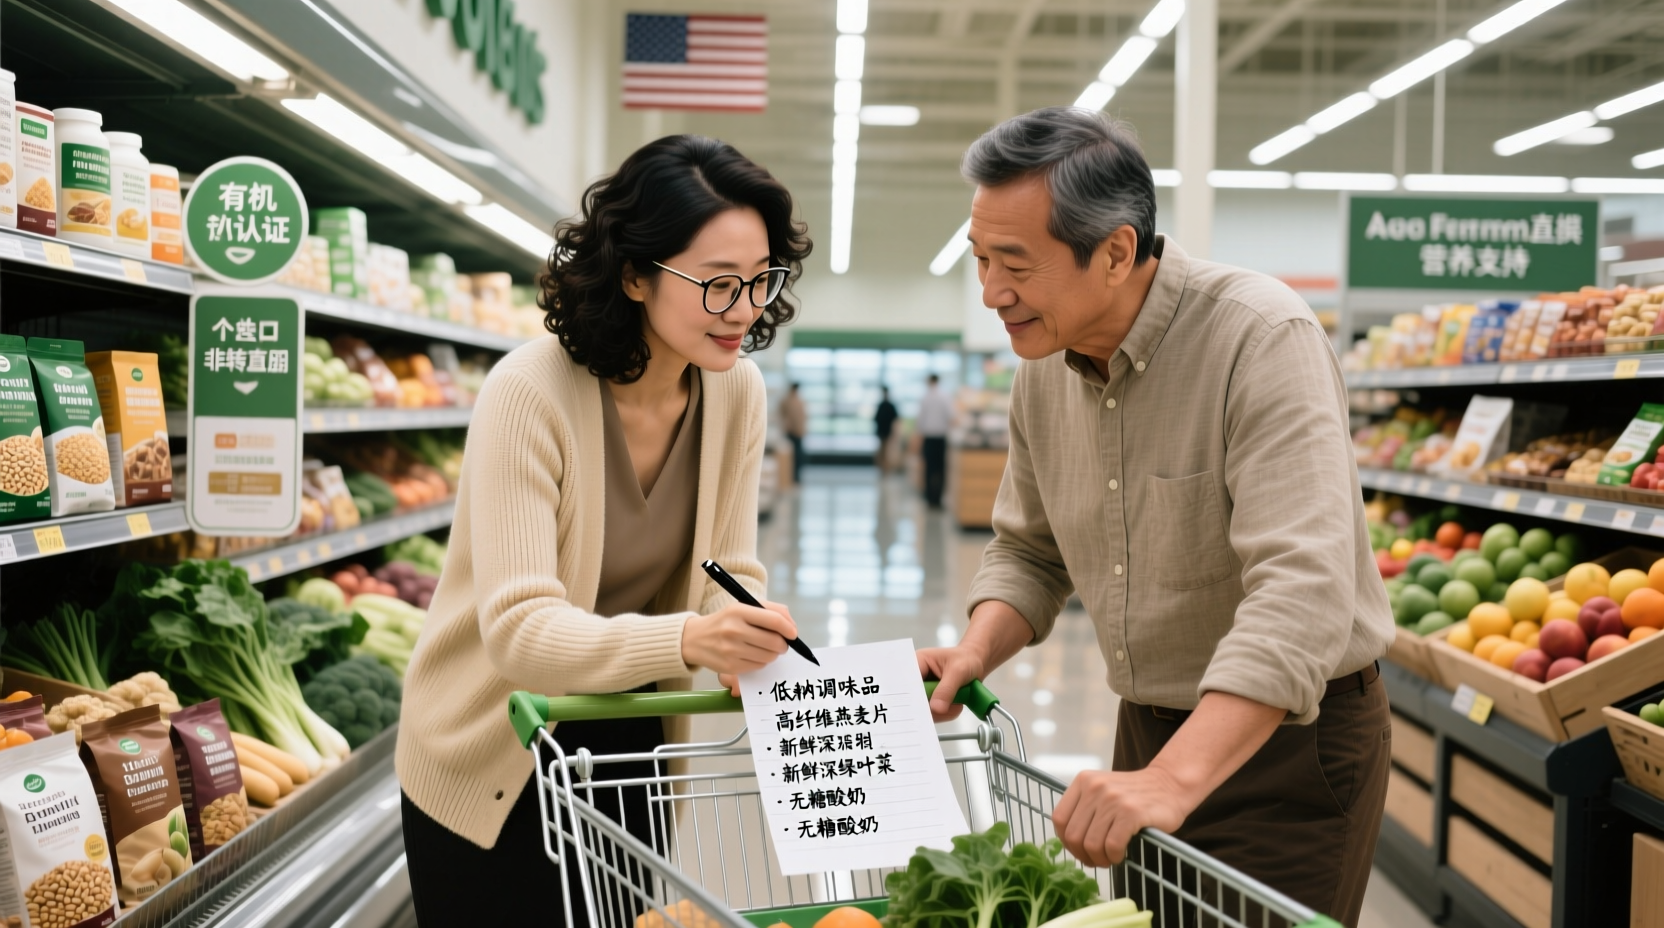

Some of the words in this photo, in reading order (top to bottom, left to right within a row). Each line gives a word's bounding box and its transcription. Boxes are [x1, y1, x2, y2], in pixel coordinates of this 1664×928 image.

[219, 181, 278, 212] 有机
[776, 704, 888, 732] 高纤维燕麦片
[782, 753, 896, 784] 新鲜深绿叶菜
[790, 787, 866, 811] 无糖酸奶
[798, 816, 879, 839] 无糖酸奶
